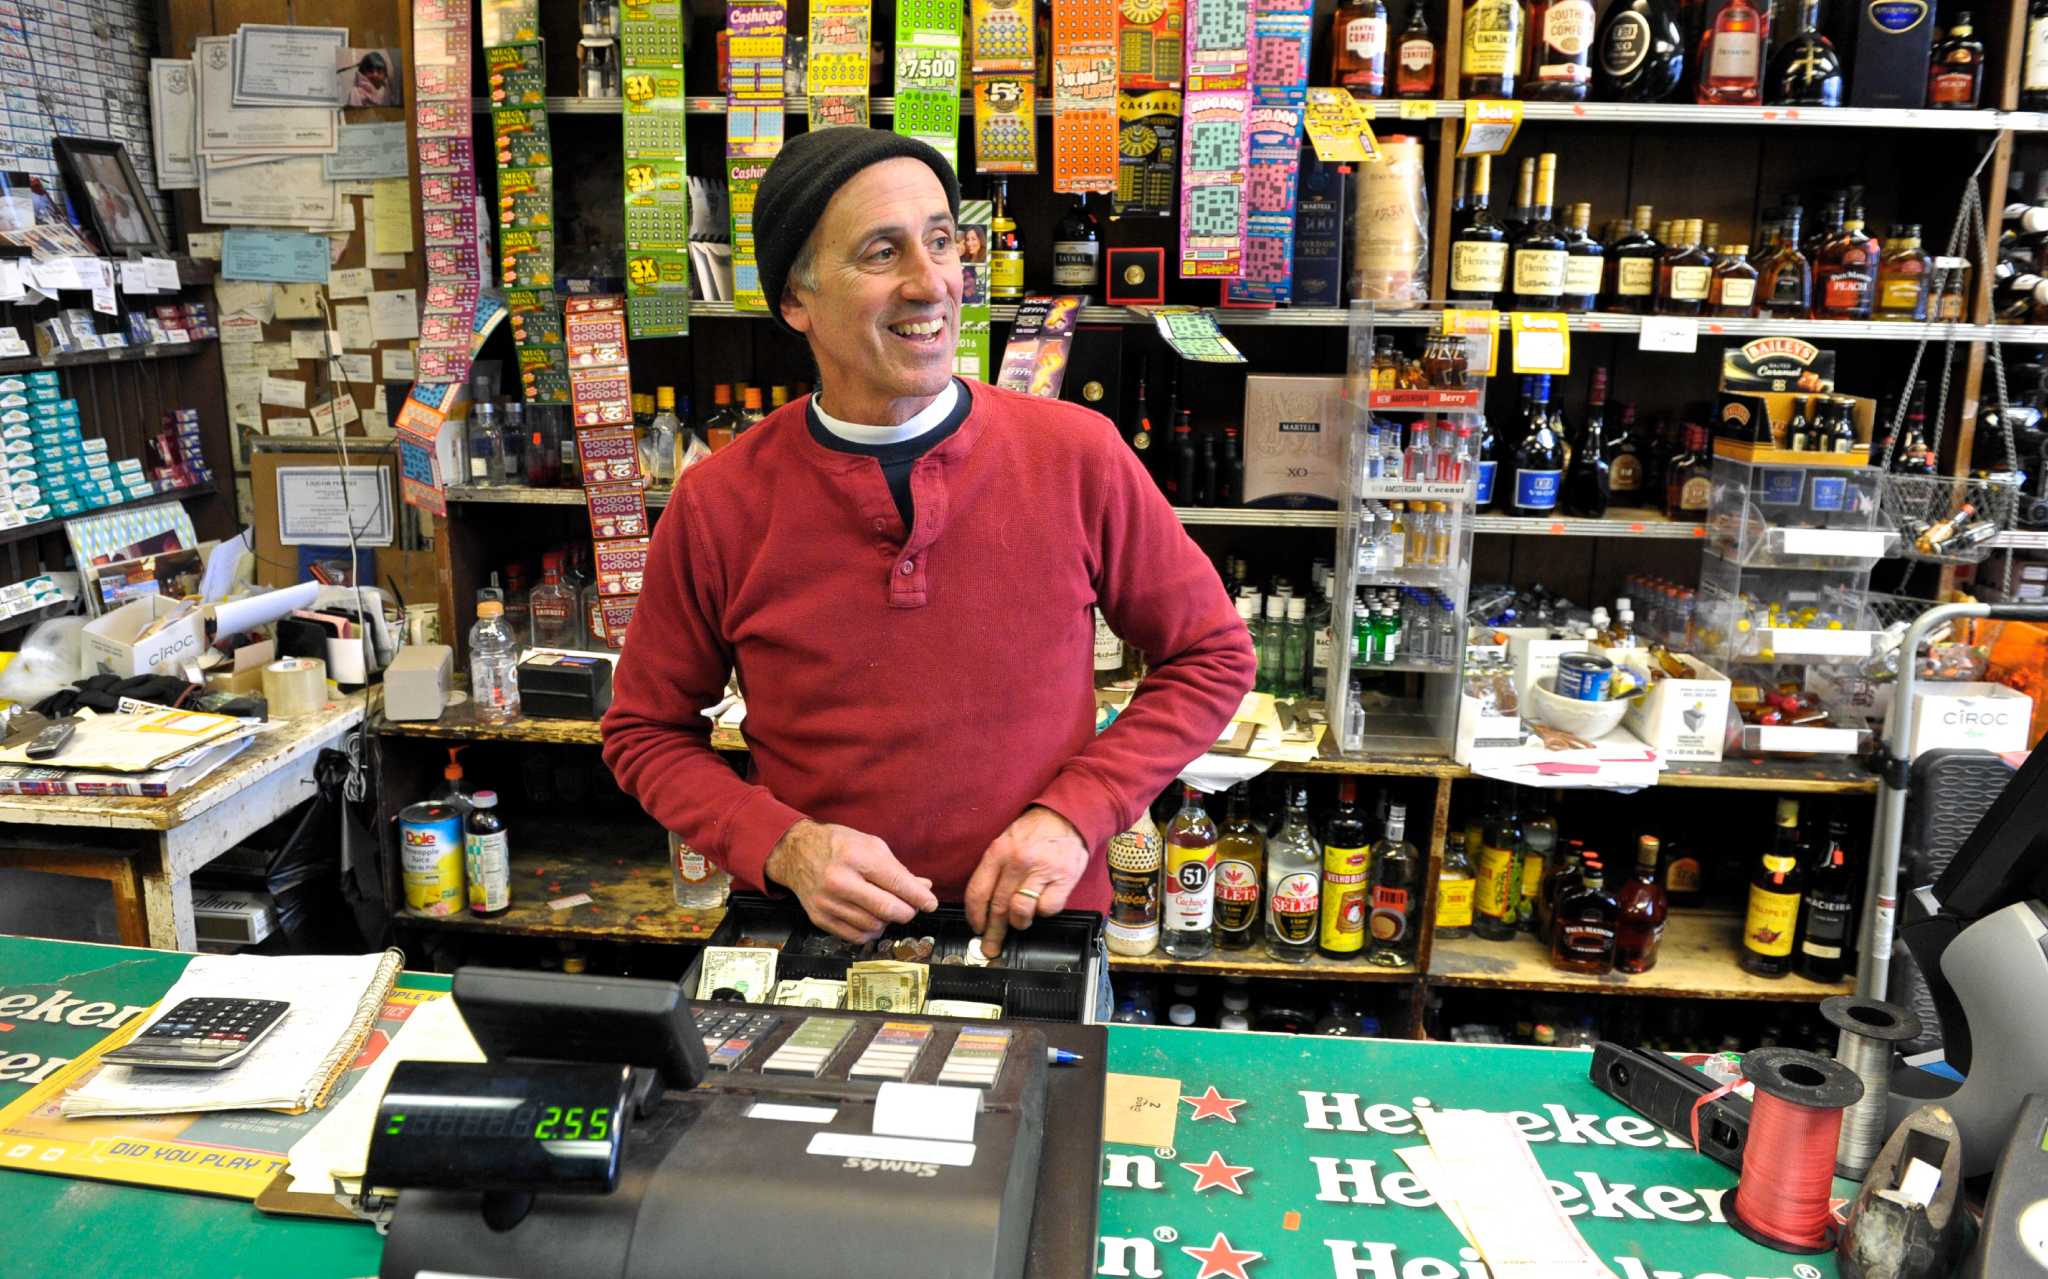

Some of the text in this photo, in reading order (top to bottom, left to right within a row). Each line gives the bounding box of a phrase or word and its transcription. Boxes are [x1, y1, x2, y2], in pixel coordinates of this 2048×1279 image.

[730, 8, 784, 25] Cashingo
[625, 75, 653, 95] 3X
[1119, 101, 1178, 111] CAESARS
[627, 167, 654, 188] 3X
[731, 166, 768, 180] Cashin
[630, 259, 657, 278] 3X
[1833, 282, 1868, 291] PEACH
[1748, 340, 1812, 359] BAILEYS
[1757, 365, 1802, 377] Caramel
[1439, 393, 1466, 404] Berry
[1288, 467, 1308, 477] XO
[1427, 485, 1465, 494] Coconut
[405, 830, 436, 845] Dole
[1183, 868, 1203, 885] 51
[110, 1142, 151, 1157] DID
[154, 1147, 200, 1163] YOU
[199, 1153, 262, 1170] PLAY
